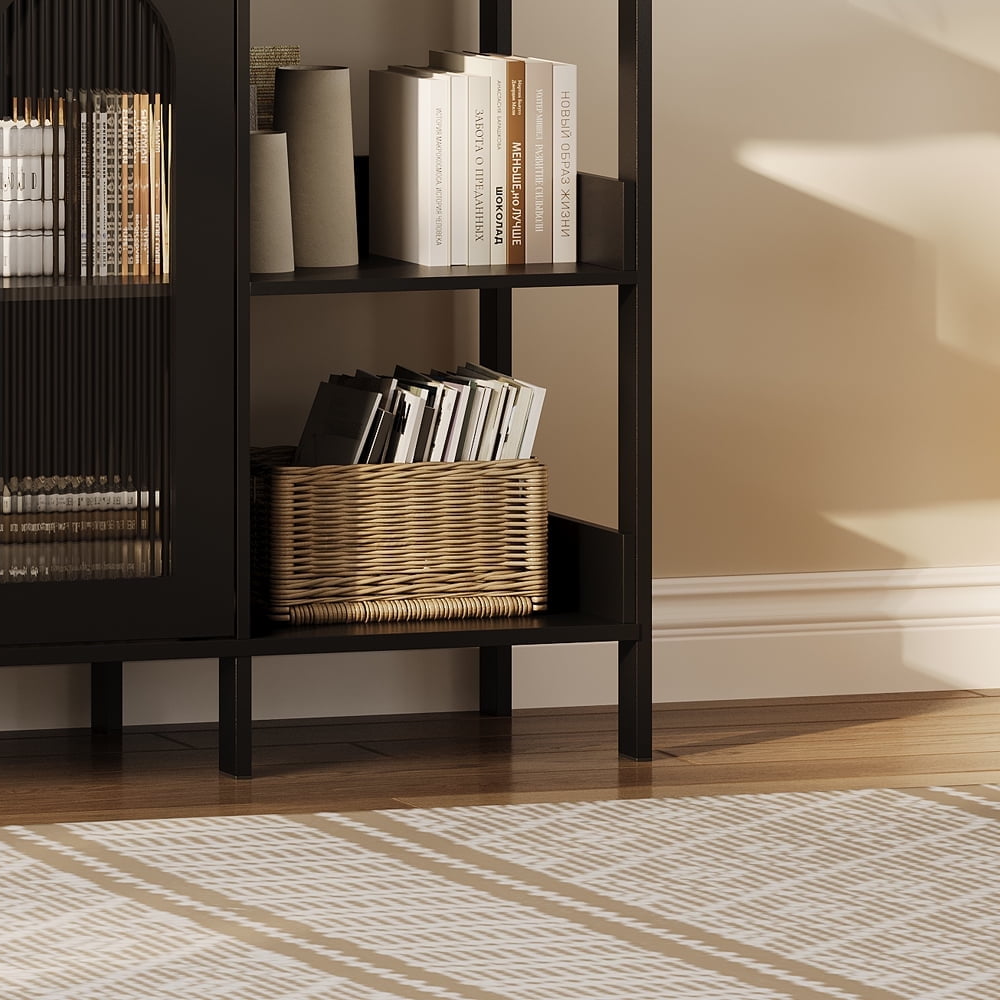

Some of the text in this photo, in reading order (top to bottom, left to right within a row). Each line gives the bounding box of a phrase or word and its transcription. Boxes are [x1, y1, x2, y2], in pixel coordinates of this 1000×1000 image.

[474, 109, 484, 242] ЗАБОТА О ПРЕДАННЫХ
[535, 144, 544, 186] РАЗВИТИЕ
[561, 91, 572, 238] НОВЫЙ ОБРАЗ ЖИЗНИ
[494, 186, 503, 245] ШОКОЛАД
[512, 207, 522, 246] ЛУЧШЕ
